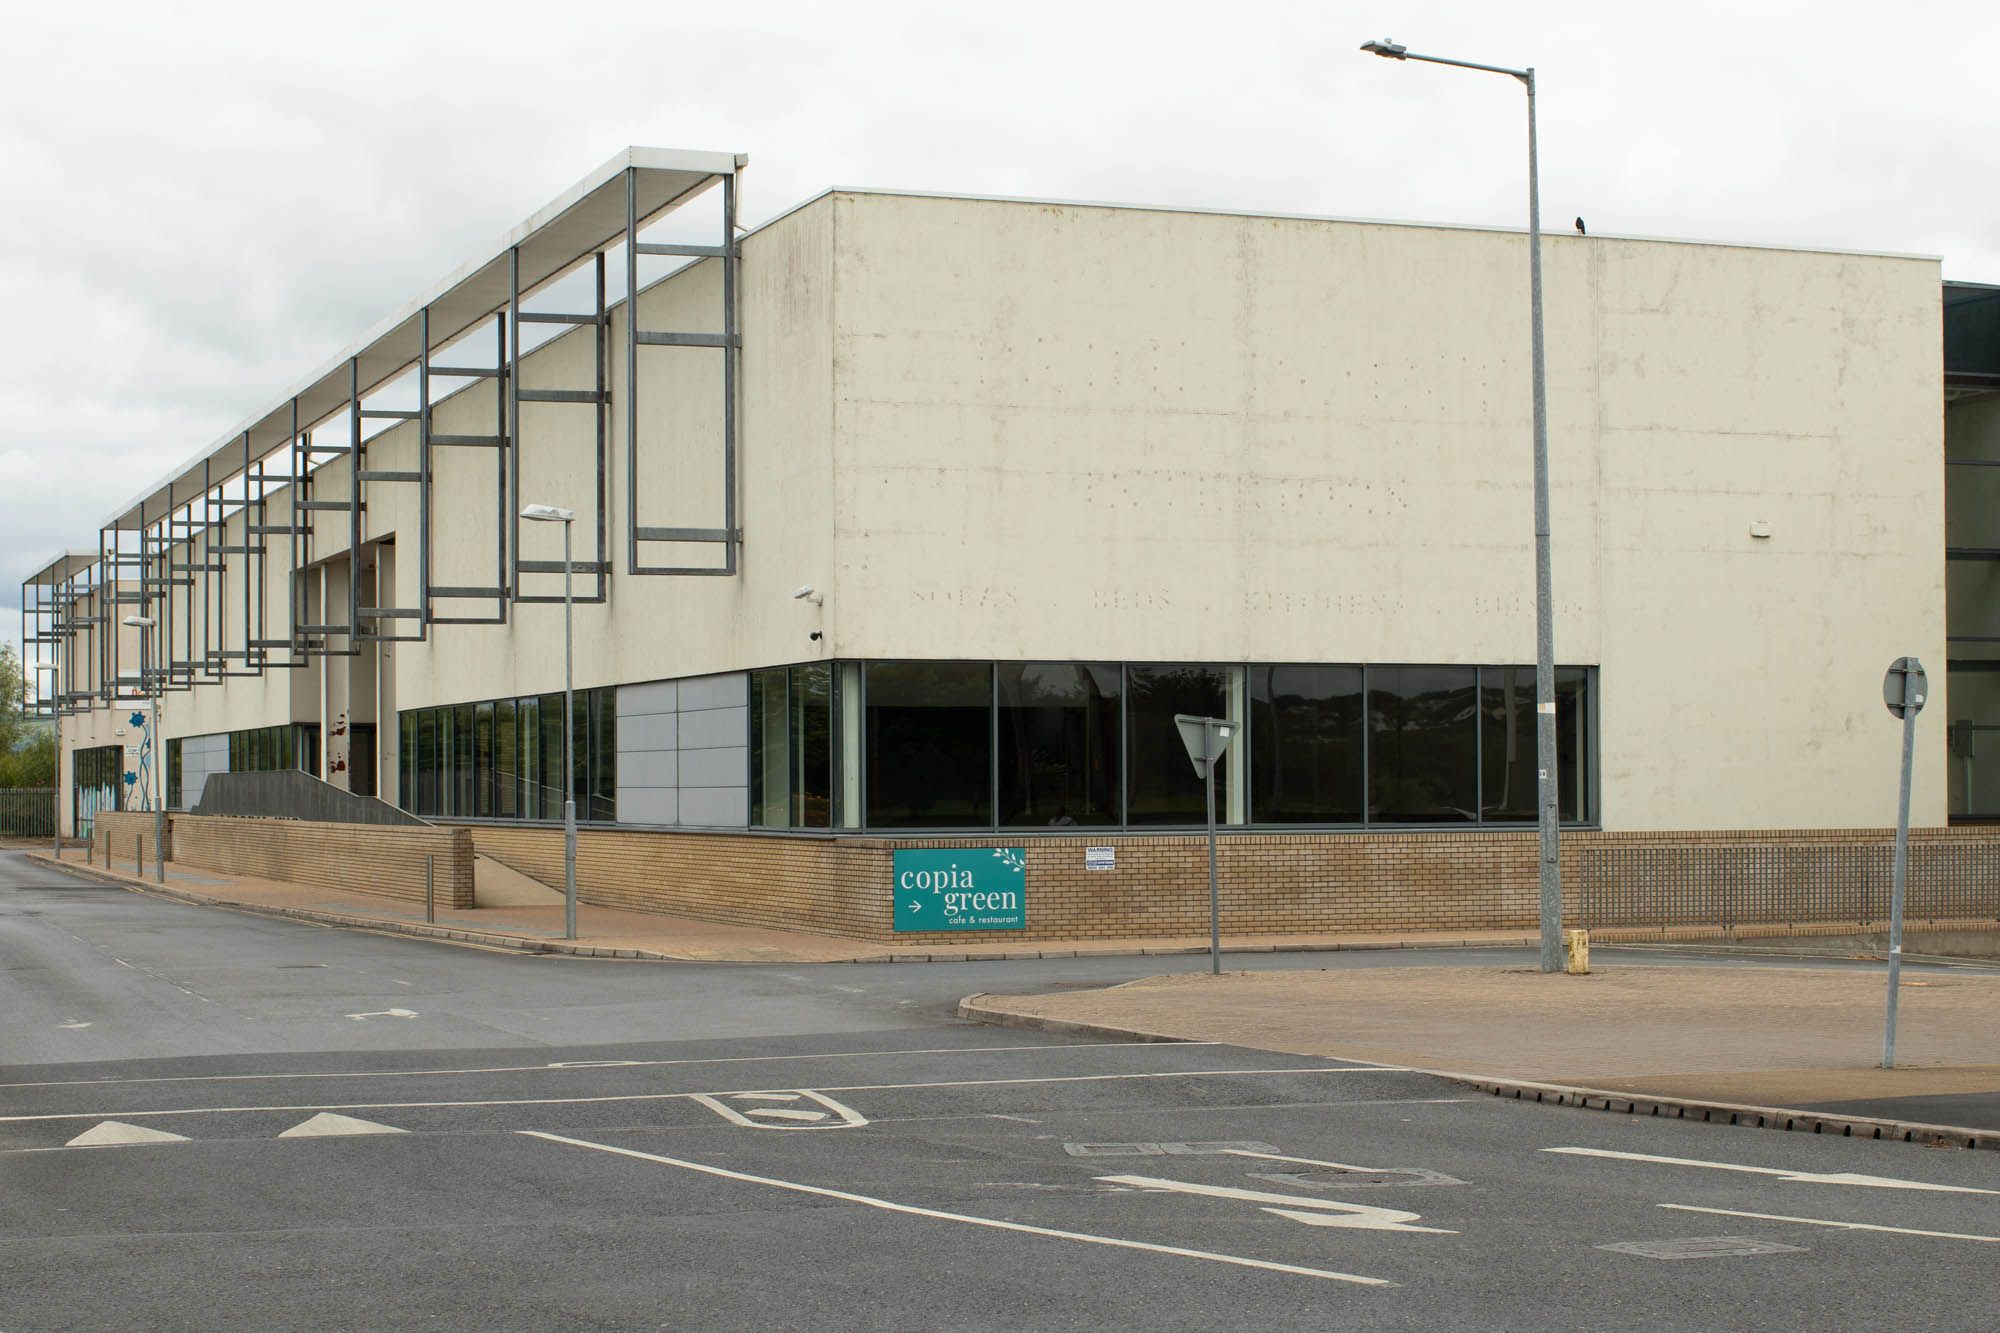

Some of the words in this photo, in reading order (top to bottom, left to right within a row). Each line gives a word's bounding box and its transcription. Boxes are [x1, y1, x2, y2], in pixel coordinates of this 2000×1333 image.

[900, 863, 974, 894] copia
[943, 891, 1017, 916] green
[969, 915, 976, 924] &
[978, 915, 1019, 924] restaurant
